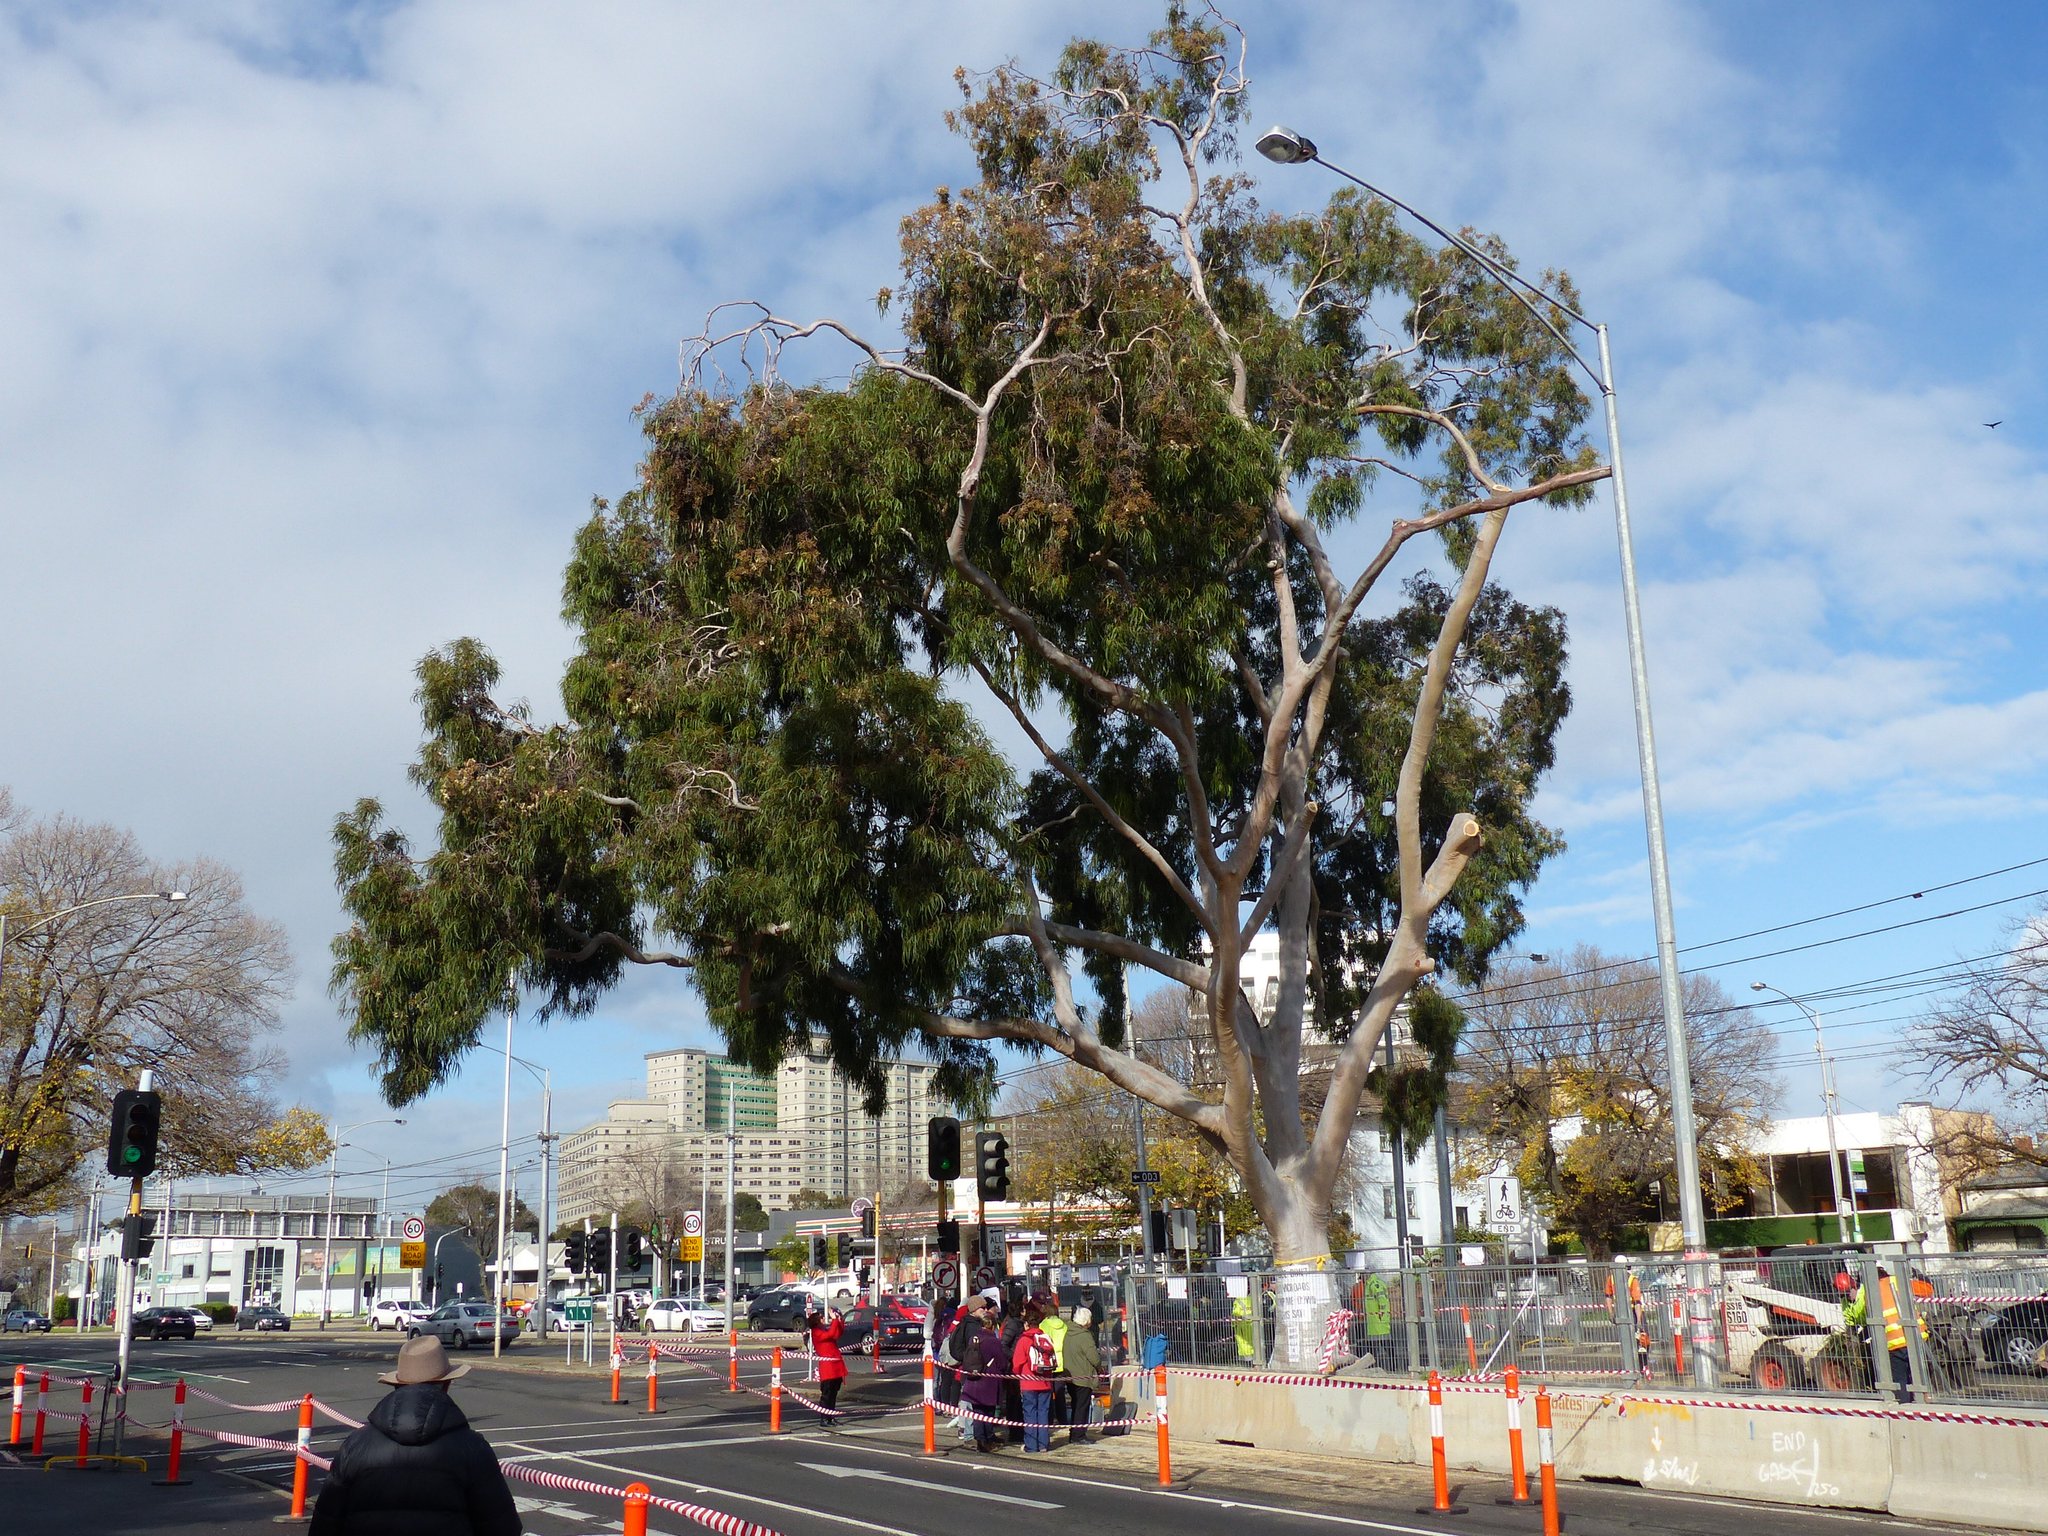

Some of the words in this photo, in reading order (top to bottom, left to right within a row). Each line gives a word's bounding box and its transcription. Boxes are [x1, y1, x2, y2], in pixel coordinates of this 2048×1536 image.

[407, 1223, 420, 1234] 60
[687, 1219, 698, 1229] 60
[1497, 1225, 1515, 1233] END
[990, 1235, 1003, 1244] ALL
[406, 1244, 420, 1252] END
[1727, 1311, 1747, 1324] S160
[1772, 1431, 1806, 1452] END
